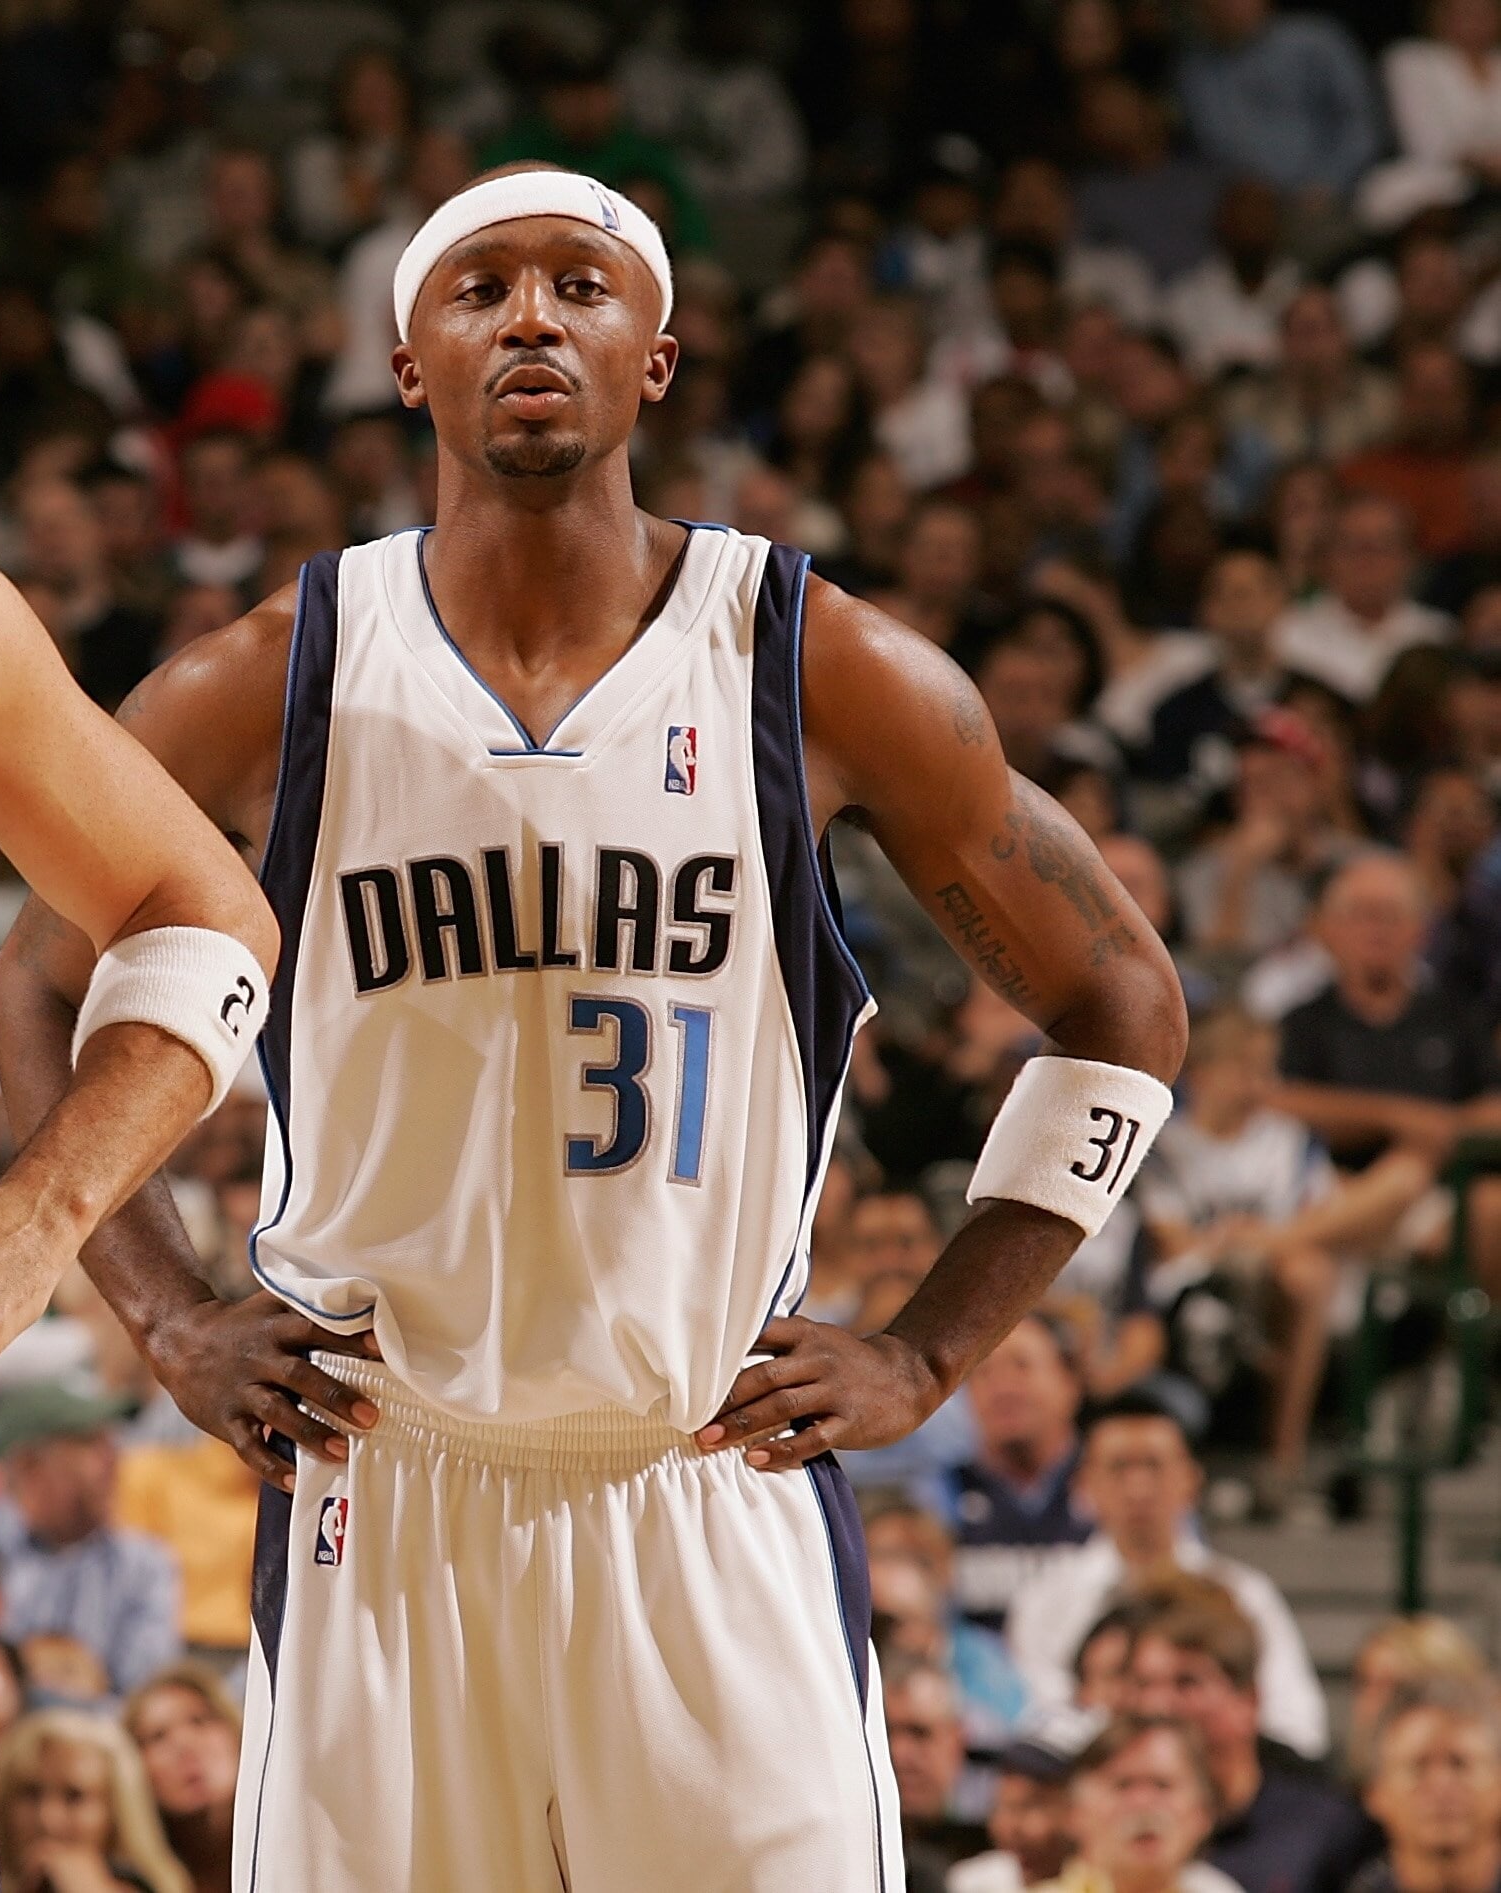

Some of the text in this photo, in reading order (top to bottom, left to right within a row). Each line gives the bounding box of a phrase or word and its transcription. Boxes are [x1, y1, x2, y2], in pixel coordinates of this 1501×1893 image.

[668, 778, 686, 790] NBA
[336, 841, 740, 999] DALLAS
[220, 975, 255, 1037] 2
[564, 991, 717, 1187] 31
[1070, 1107, 1140, 1195] 31
